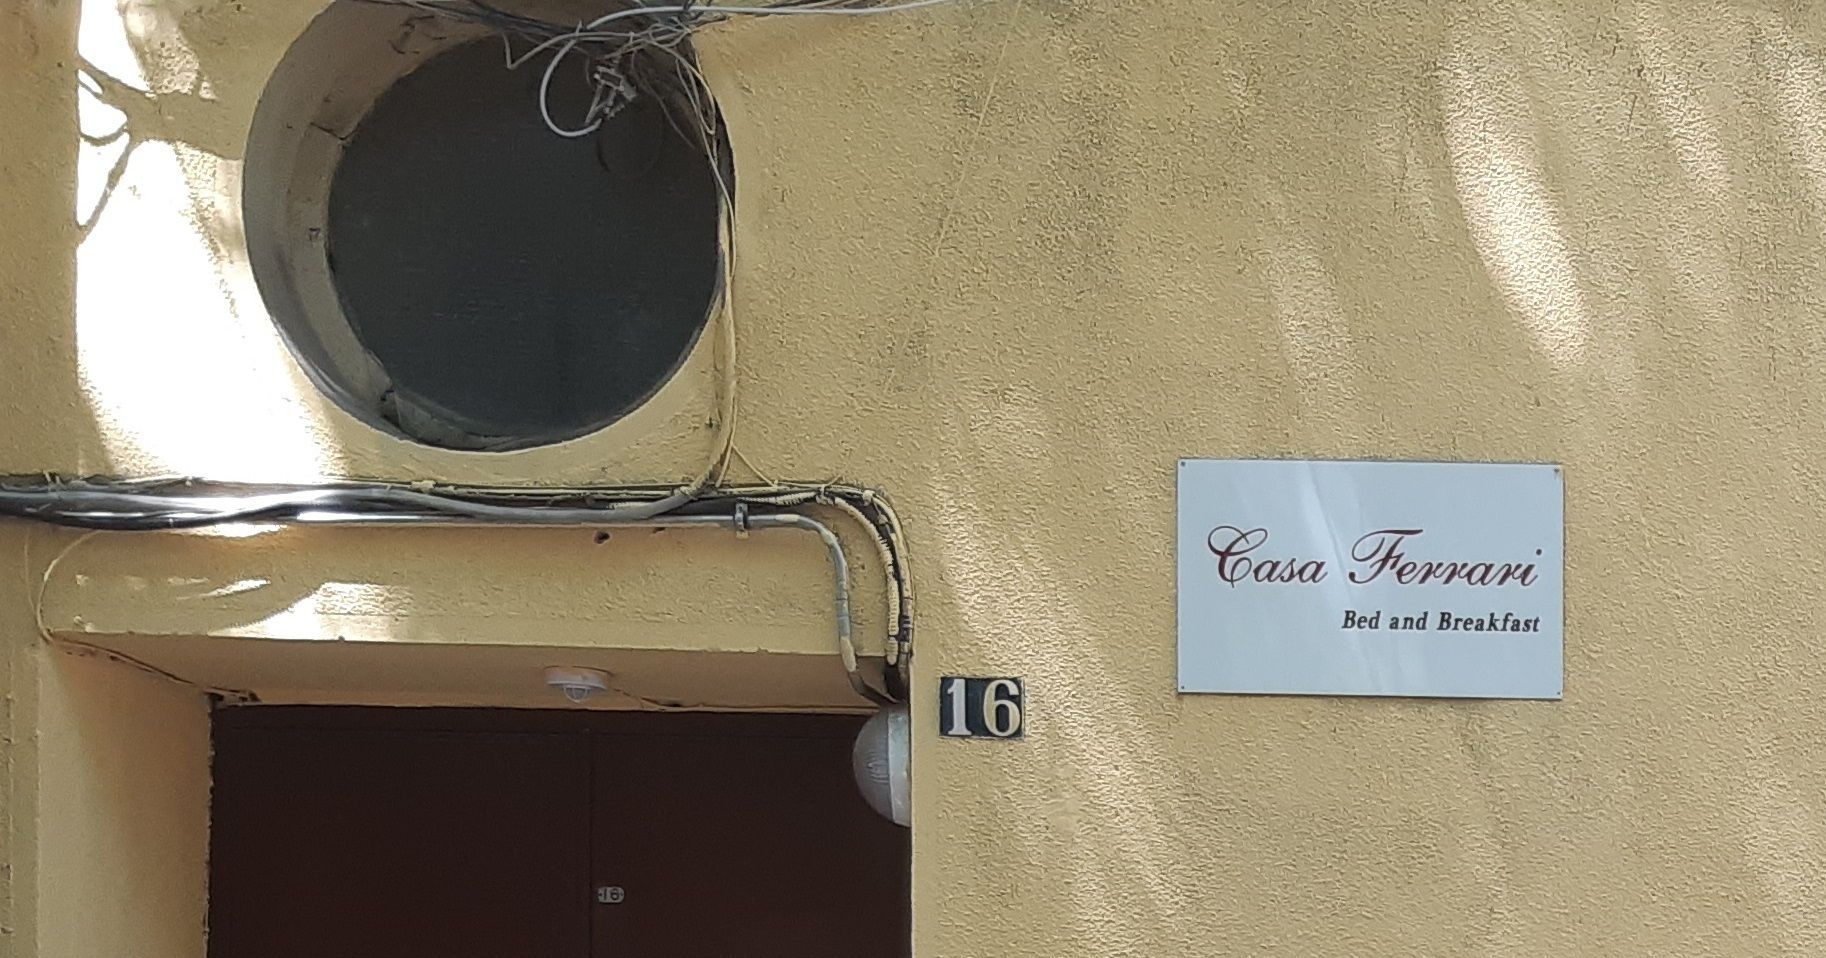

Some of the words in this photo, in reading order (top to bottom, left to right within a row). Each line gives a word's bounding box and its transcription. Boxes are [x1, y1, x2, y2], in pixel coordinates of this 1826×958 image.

[1207, 525, 1328, 588] Casa
[1347, 528, 1543, 587] Ferrari
[1341, 609, 1381, 631] Bed
[1388, 611, 1429, 632] and
[1436, 611, 1541, 634] Breakfast
[946, 677, 1021, 737] 16
